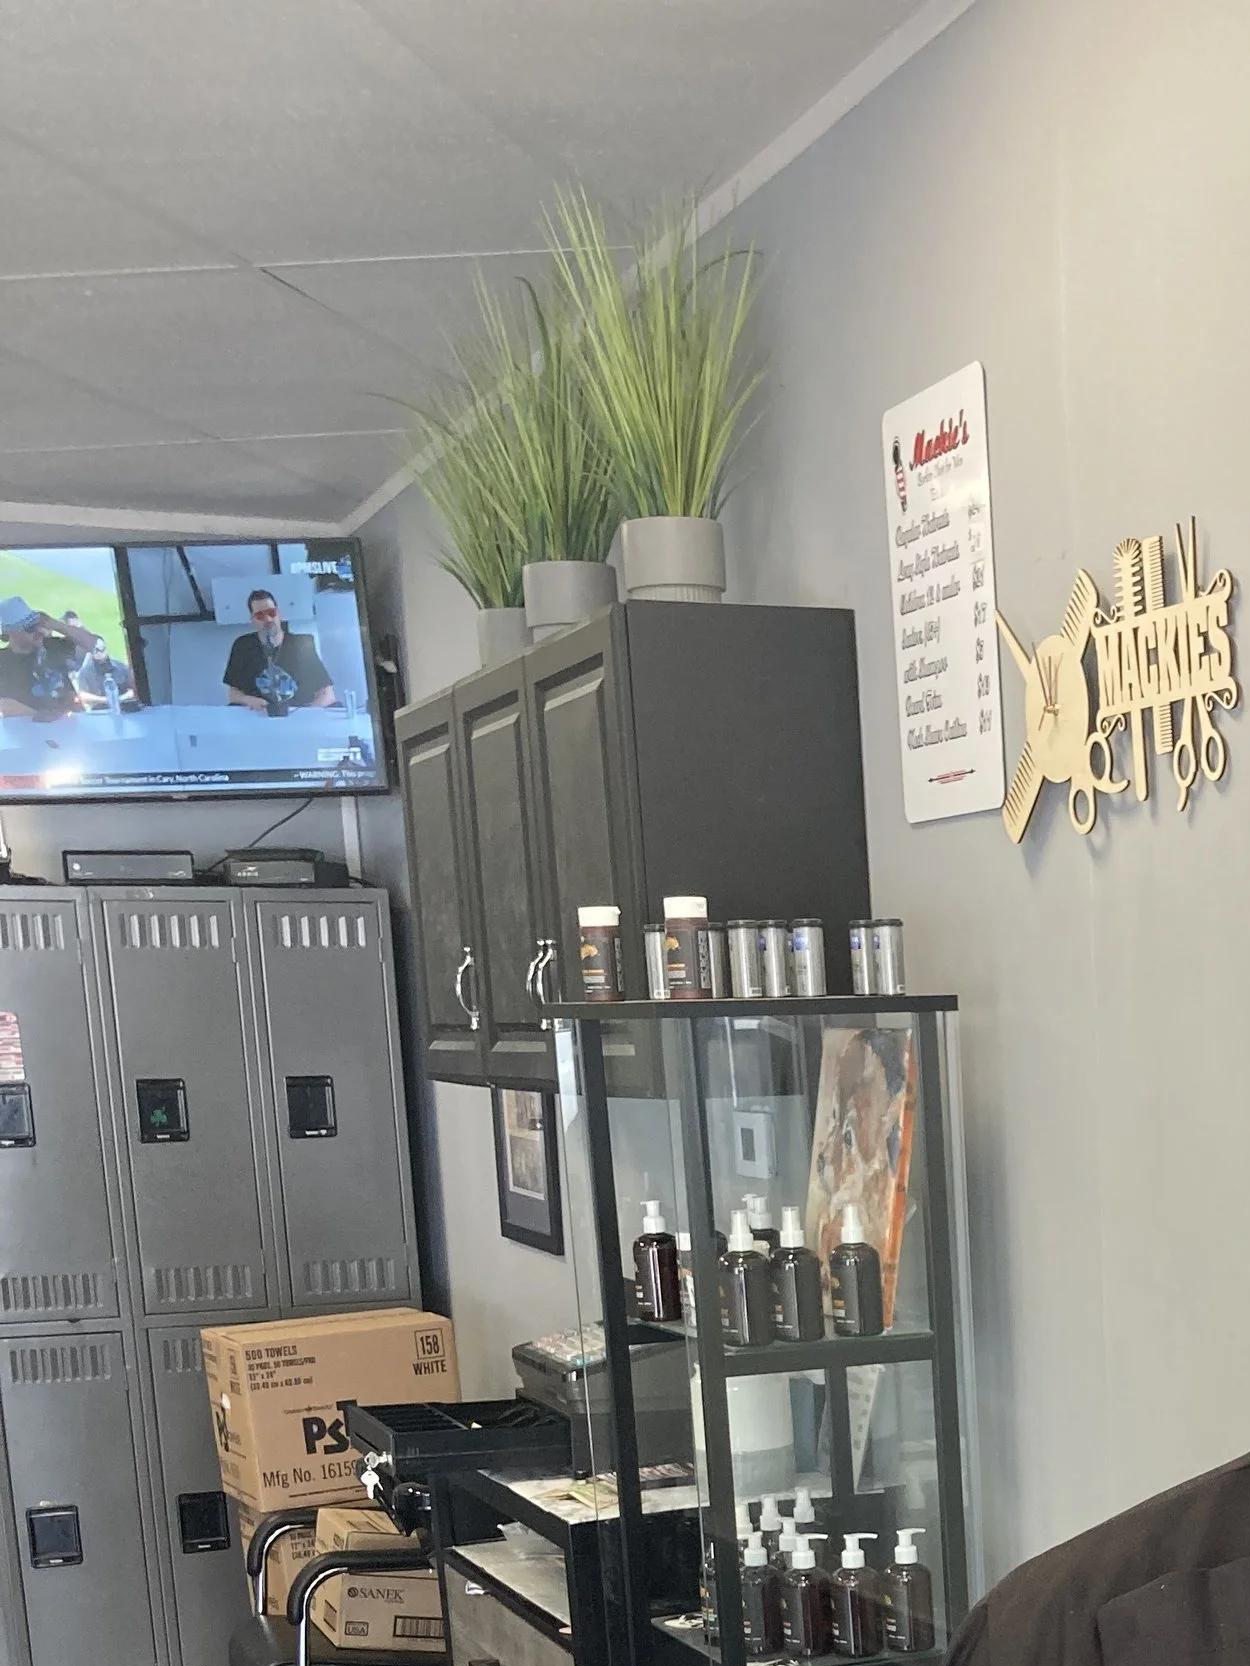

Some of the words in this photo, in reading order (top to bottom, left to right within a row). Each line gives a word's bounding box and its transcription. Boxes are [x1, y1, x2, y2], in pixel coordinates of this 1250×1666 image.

[909, 409, 970, 471] Mackie's
[1097, 604, 1231, 709] MACKIES
[175, 774, 199, 782] North
[199, 773, 230, 781] Carolina
[245, 1349, 263, 1361] 500
[265, 1345, 297, 1358] TOWELS
[420, 1334, 440, 1355] 158
[412, 1360, 447, 1375] WHITE
[262, 1470, 290, 1489] Mfg
[293, 1467, 316, 1484] No.
[348, 1626, 365, 1634] USA
